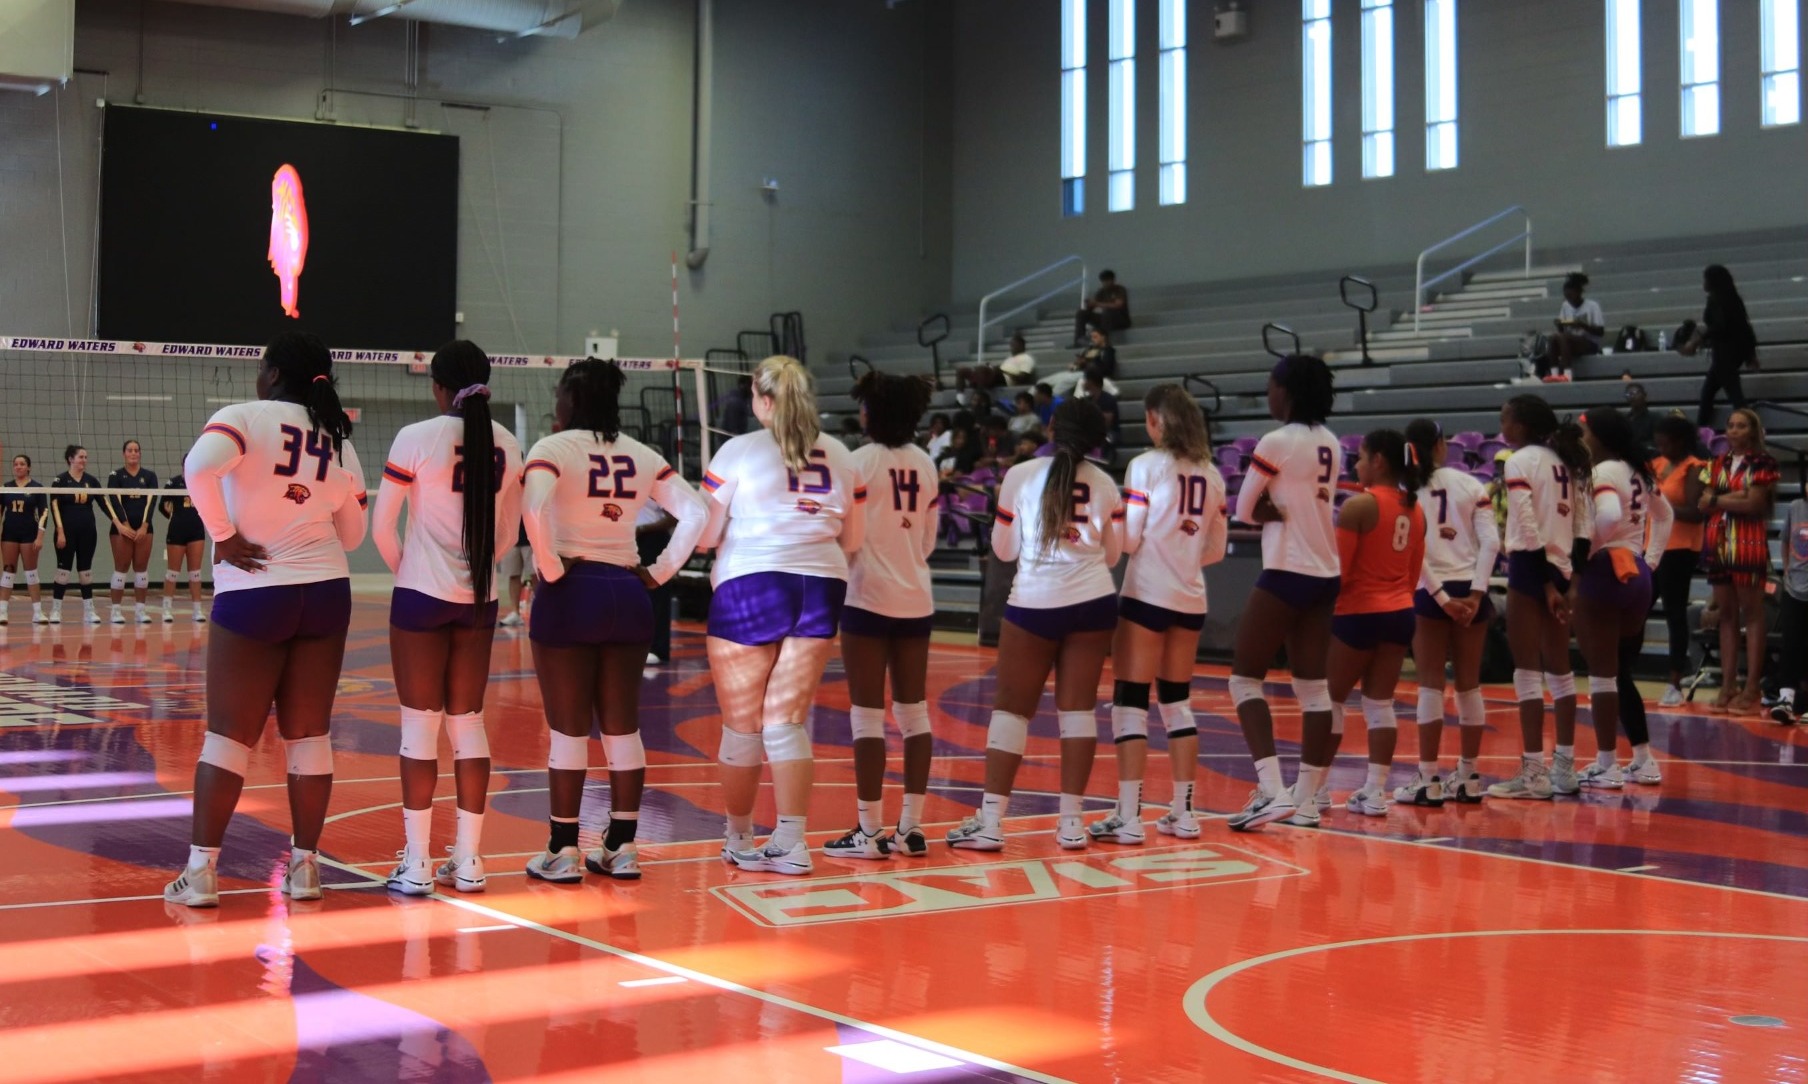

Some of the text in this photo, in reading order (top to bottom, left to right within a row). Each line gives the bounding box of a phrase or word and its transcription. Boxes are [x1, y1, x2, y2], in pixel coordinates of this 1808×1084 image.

[12, 338, 116, 352] EDWARD WATERS
[162, 344, 261, 357] EDWARD WATERS
[356, 351, 398, 362] WATERS
[274, 424, 333, 482] 34
[1317, 446, 1332, 483] 9
[587, 453, 637, 499] 22
[889, 468, 920, 512] 14
[1552, 464, 1569, 500] 4
[1630, 478, 1642, 510] 2
[11, 500, 24, 513] 17
[1071, 482, 1090, 523] 2
[1178, 473, 1207, 516] 10
[1430, 489, 1447, 524] 7
[1392, 515, 1410, 551] 8
